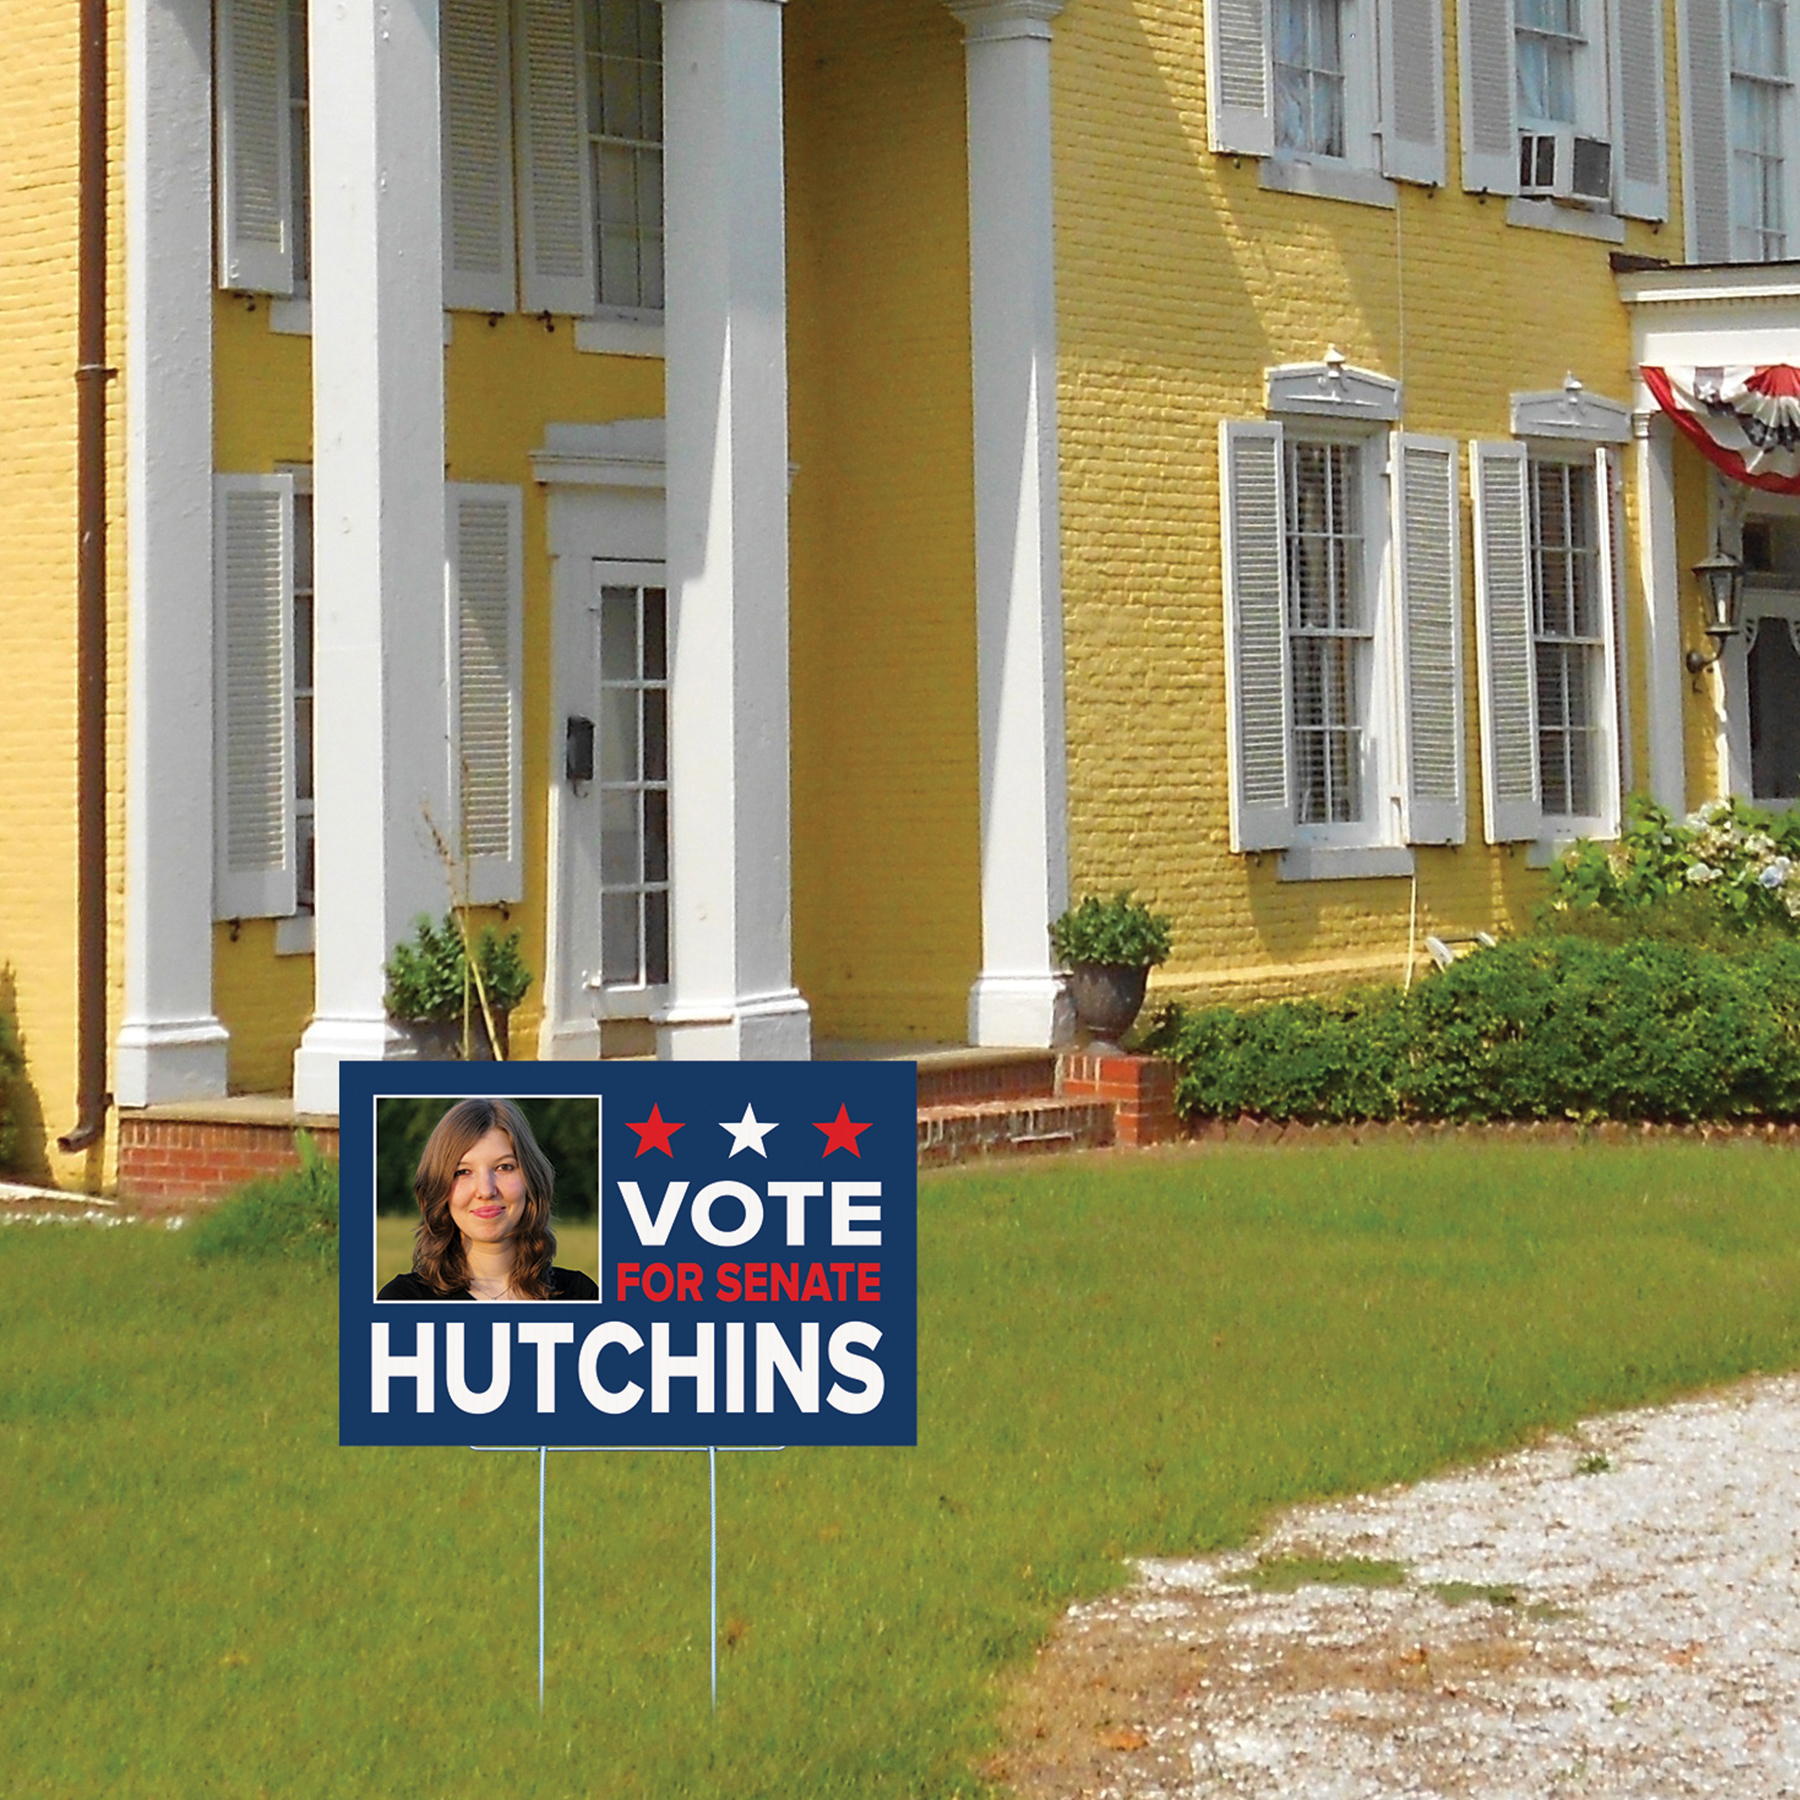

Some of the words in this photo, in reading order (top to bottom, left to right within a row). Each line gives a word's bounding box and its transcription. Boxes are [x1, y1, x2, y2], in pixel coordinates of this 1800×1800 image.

[617, 1180, 882, 1247] VOTE
[617, 1262, 704, 1302] FOR
[716, 1262, 881, 1302] SENATE
[371, 1321, 885, 1414] HUTCHINS
